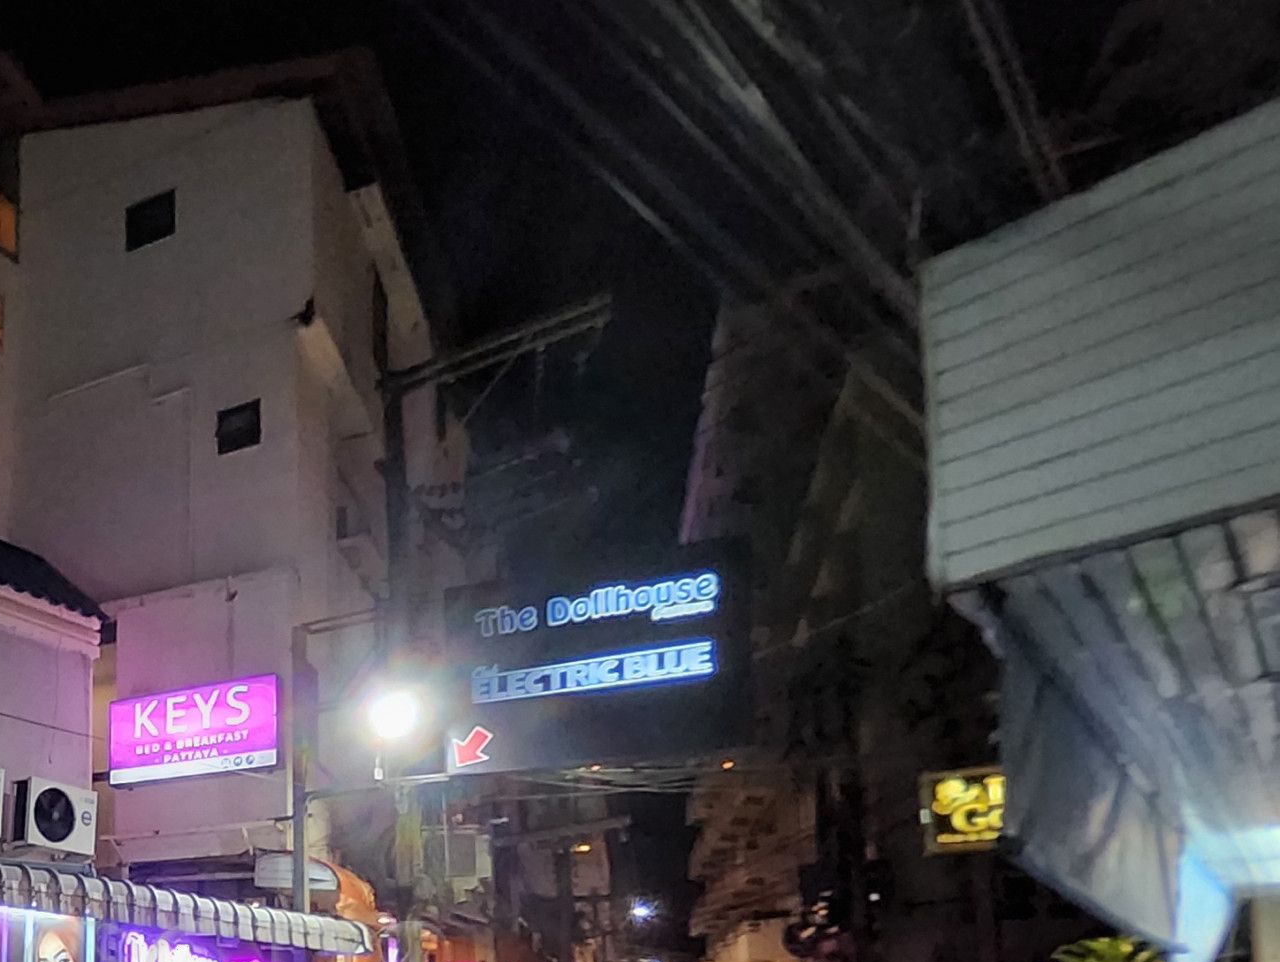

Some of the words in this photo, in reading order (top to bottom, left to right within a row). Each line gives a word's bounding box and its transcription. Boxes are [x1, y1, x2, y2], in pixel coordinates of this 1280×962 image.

[474, 605, 538, 637] The
[546, 573, 719, 627] Dollhouse
[472, 660, 620, 701] ELECTRIC
[623, 645, 713, 679] BLUE
[133, 685, 251, 739] KEYS
[163, 747, 219, 763] PATTAYA
[176, 729, 249, 750] BREAKFAST
